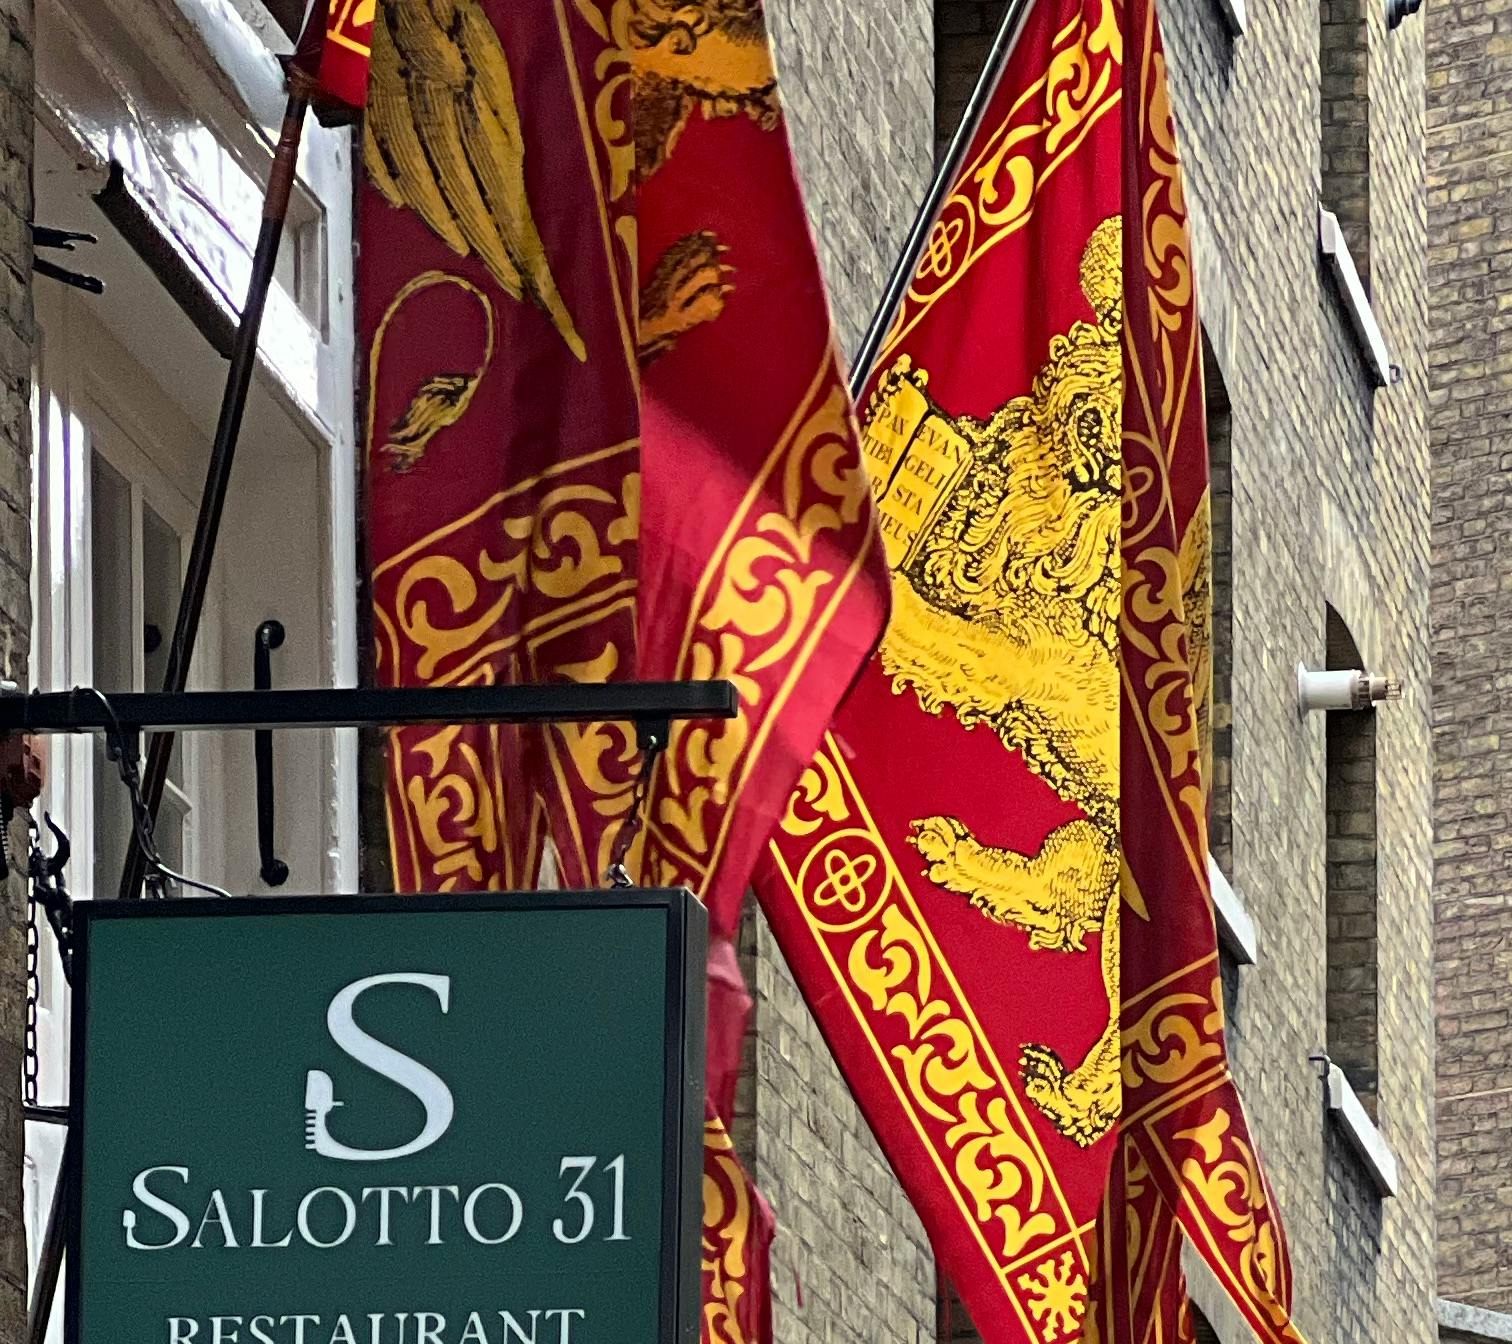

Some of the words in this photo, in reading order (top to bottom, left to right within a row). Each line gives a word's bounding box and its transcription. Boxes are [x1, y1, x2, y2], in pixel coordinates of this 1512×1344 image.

[917, 424, 962, 465] EVAN
[904, 454, 946, 489] GELI
[892, 484, 923, 515] STA
[305, 972, 454, 1160] S
[122, 1165, 523, 1250] SALOTTO
[552, 1153, 632, 1245] 31
